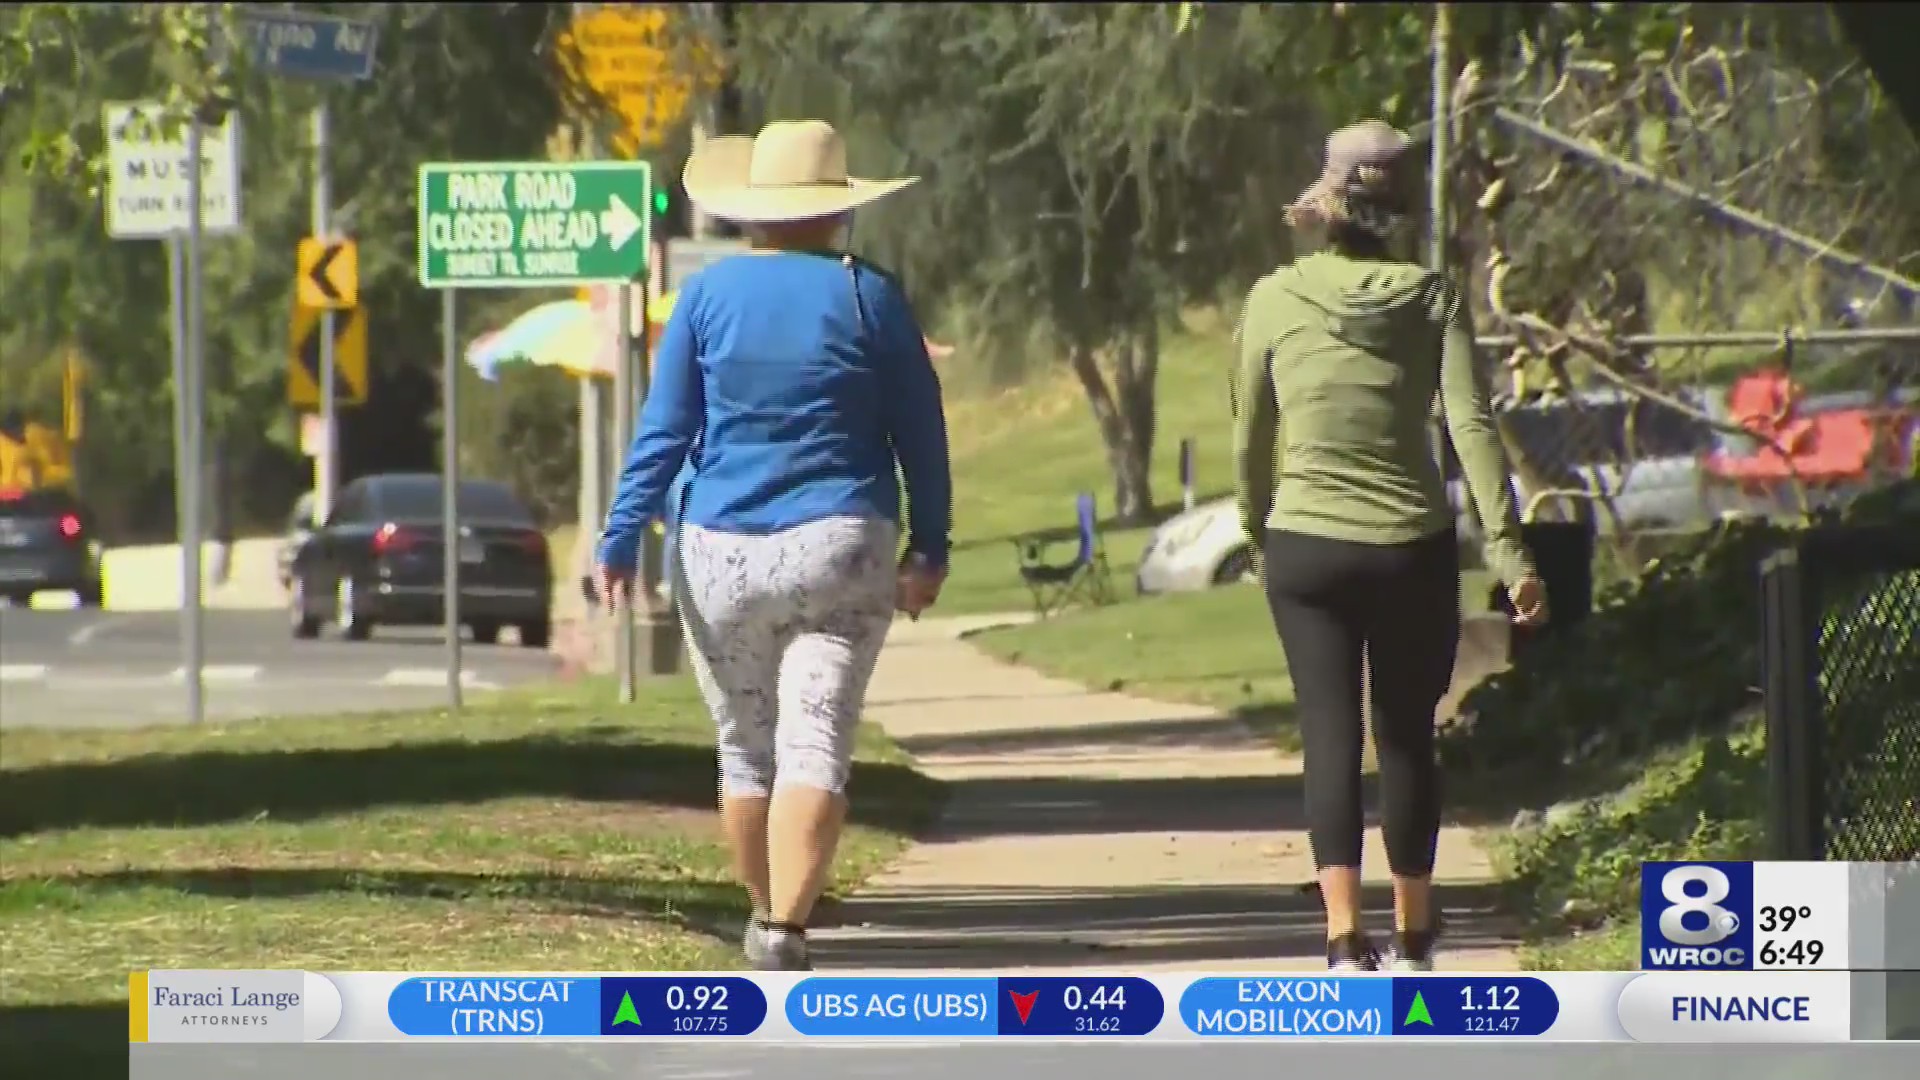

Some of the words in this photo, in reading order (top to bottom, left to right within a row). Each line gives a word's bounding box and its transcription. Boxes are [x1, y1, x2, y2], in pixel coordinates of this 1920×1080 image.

[447, 172, 508, 210] PARK
[514, 171, 577, 210] ROAD
[428, 211, 514, 251] CLOSED
[519, 209, 599, 250] AHEAD
